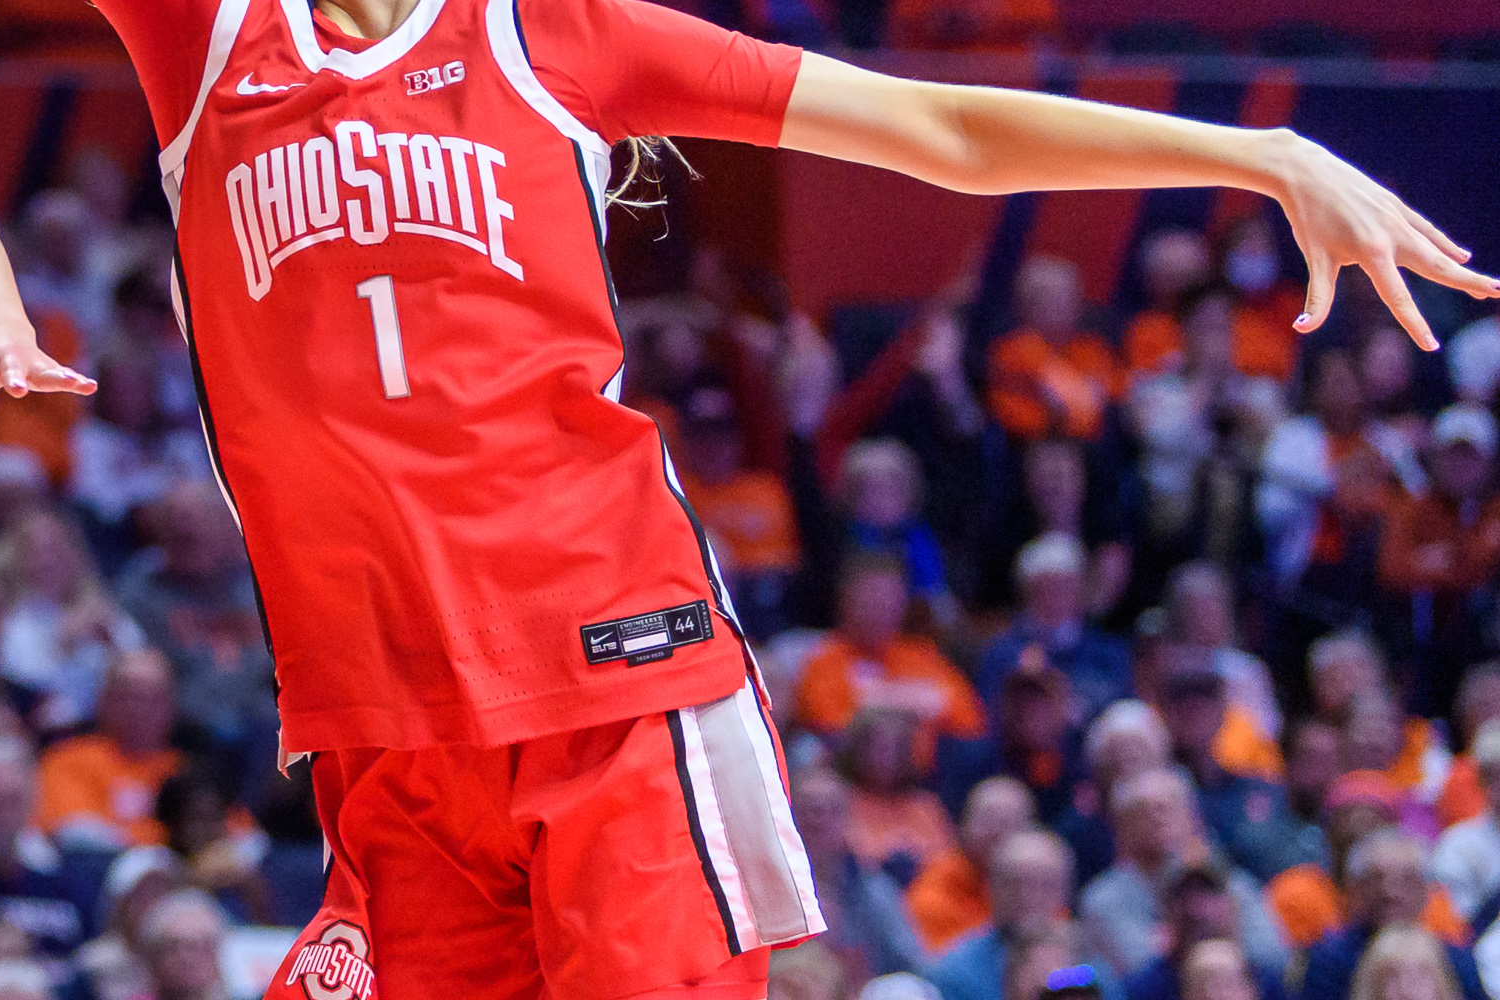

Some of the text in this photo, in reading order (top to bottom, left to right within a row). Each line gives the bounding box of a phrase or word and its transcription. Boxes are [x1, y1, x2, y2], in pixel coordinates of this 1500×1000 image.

[355, 273, 412, 400] 1
[620, 616, 663, 630] ENGINEERED
[675, 616, 694, 633] 44
